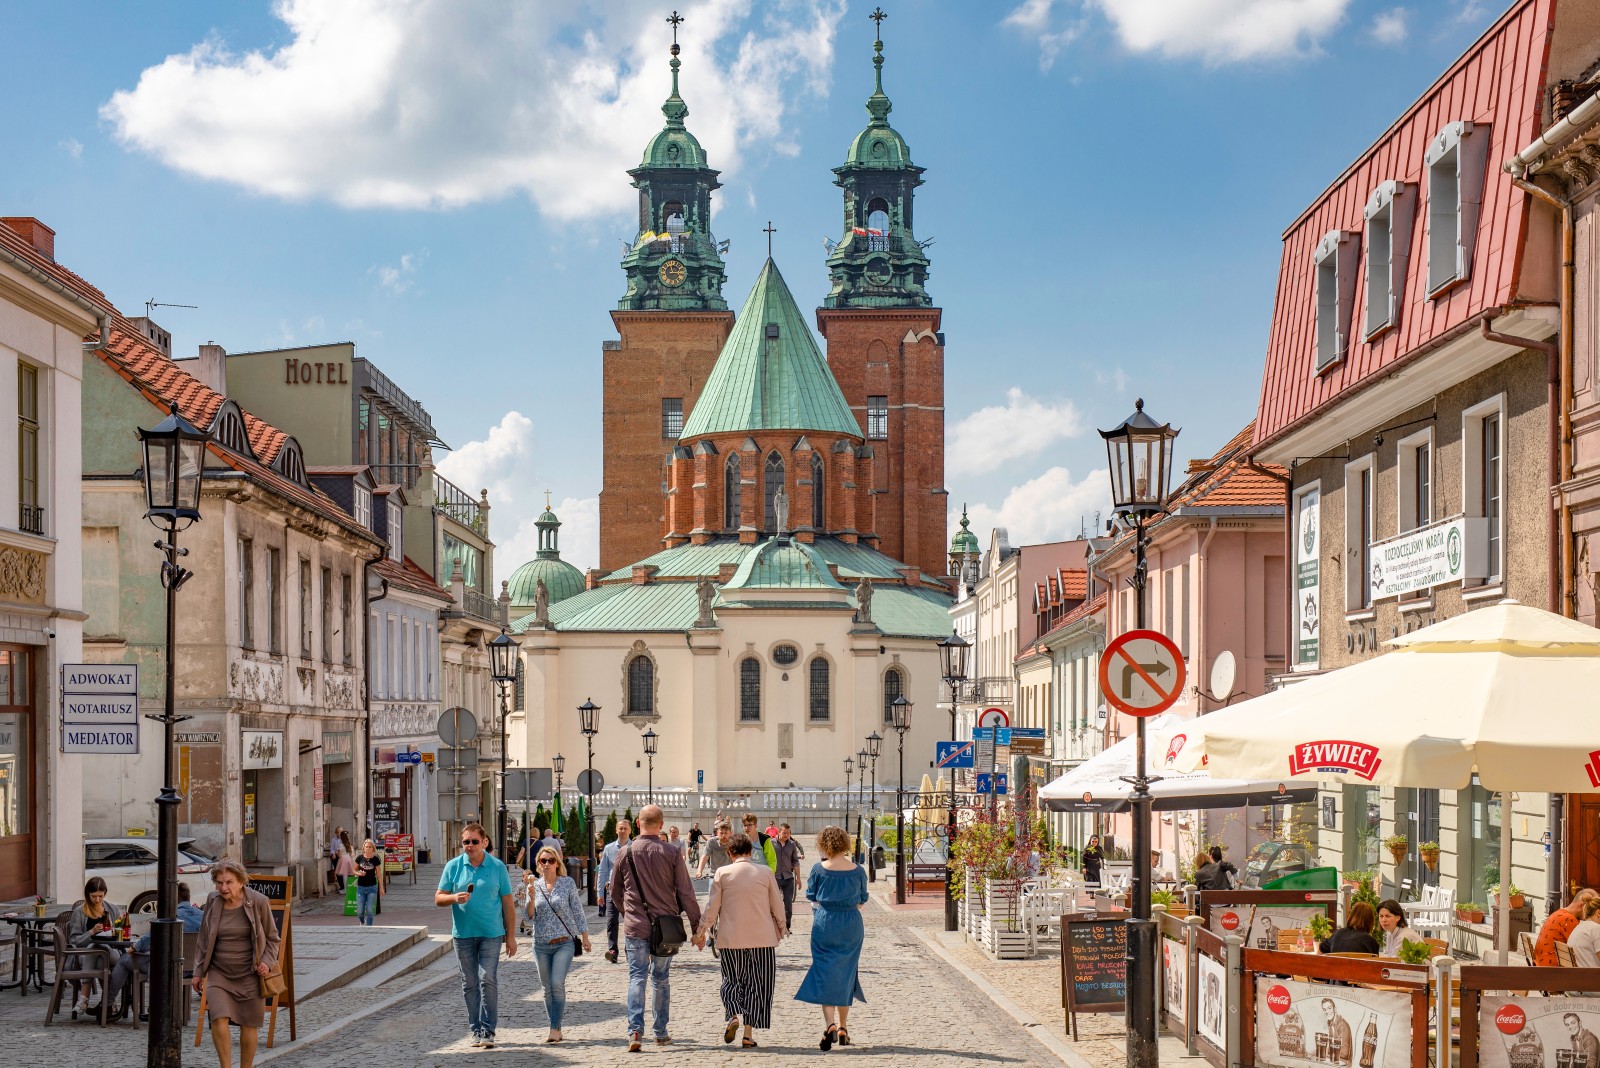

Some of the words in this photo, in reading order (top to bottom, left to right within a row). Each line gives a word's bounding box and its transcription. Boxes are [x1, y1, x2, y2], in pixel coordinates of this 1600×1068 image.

[285, 358, 348, 384] HOTEL
[69, 674, 132, 684] ADWOKAT
[69, 704, 132, 714] NOTARIUSZ
[68, 732, 133, 744] MEDIATOR
[1302, 744, 1372, 768] ŻYWIEC
[1075, 983, 1099, 992] MOJITO
[1314, 986, 1338, 996] dobrym
[1340, 990, 1360, 1001] smaku
[1268, 994, 1289, 1005] Coca-Cola
[1554, 1003, 1584, 1011] dobrym
[1497, 1014, 1524, 1024] Coca-Cola
